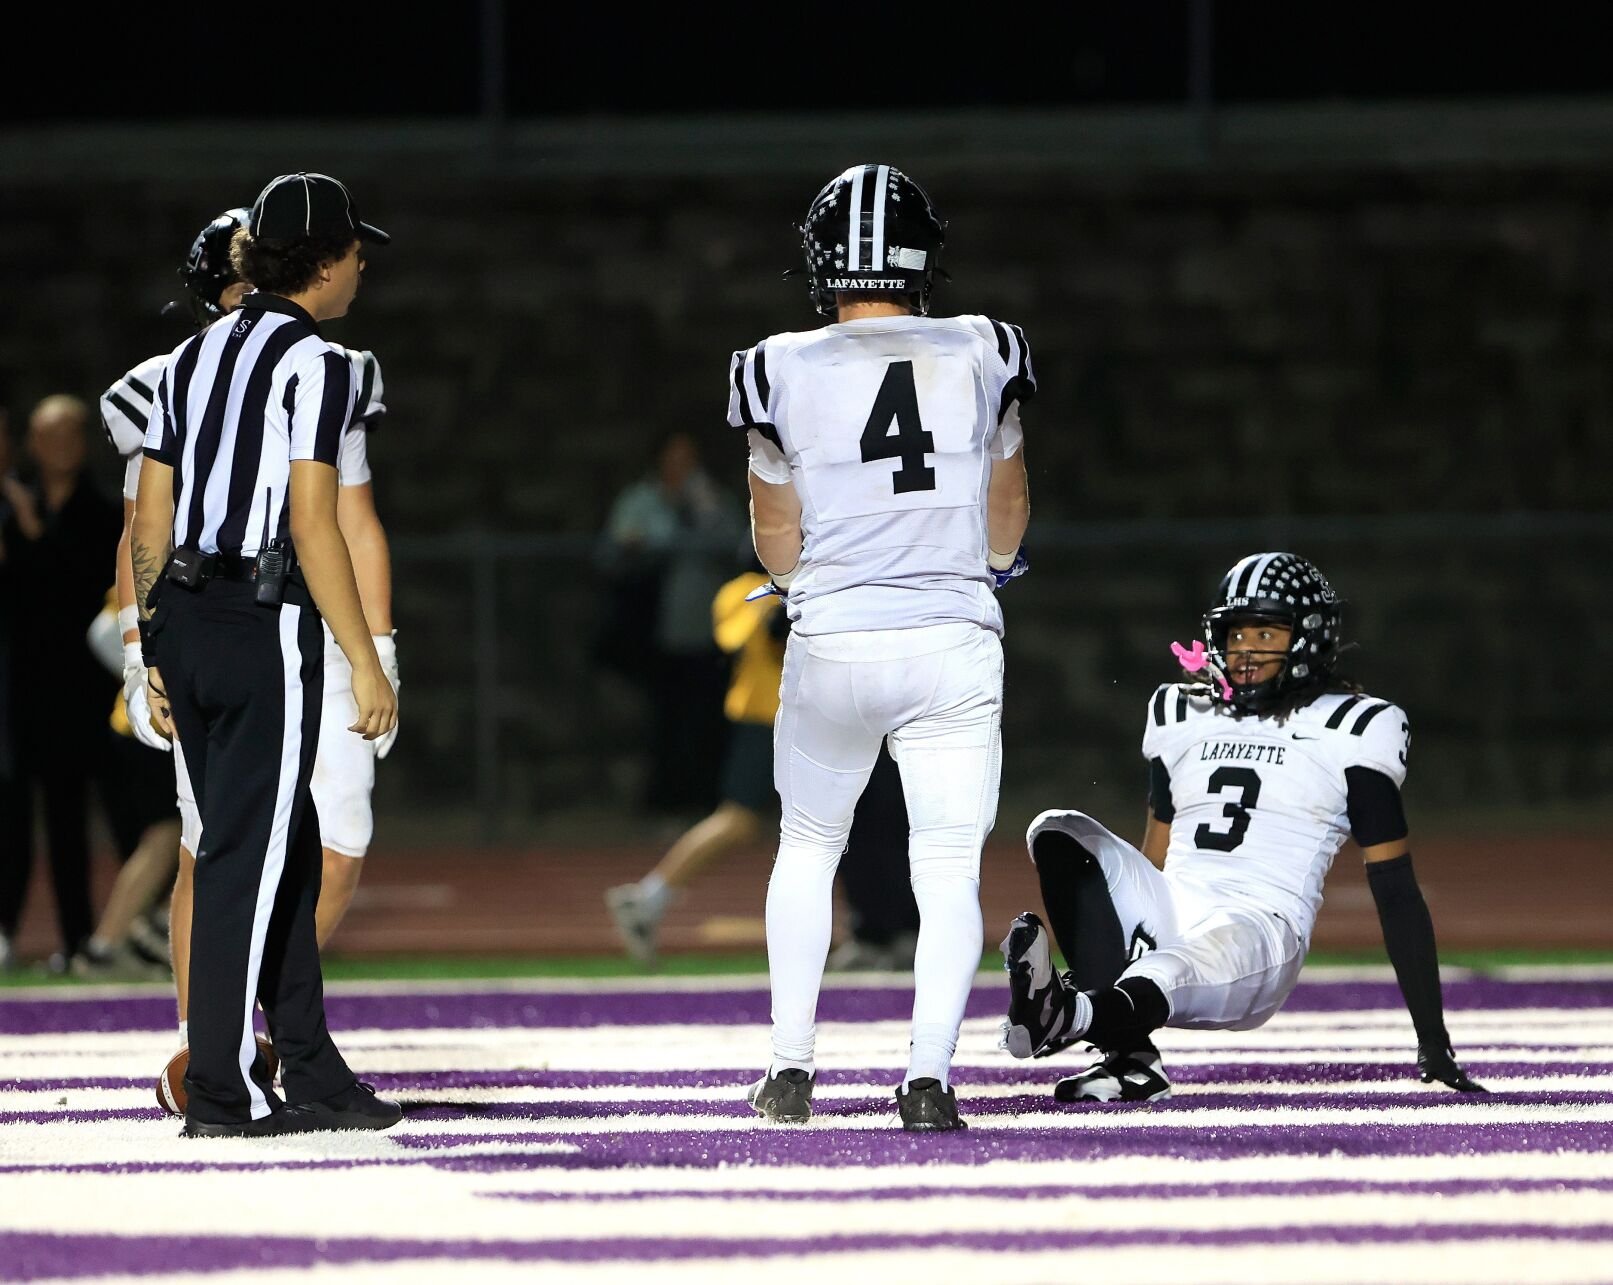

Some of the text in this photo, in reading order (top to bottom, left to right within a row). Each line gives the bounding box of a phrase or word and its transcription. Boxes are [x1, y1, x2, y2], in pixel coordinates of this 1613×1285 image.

[825, 278, 906, 289] LAFAYETTE
[859, 360, 936, 494] 4
[1225, 596, 1249, 609] LHS
[1200, 741, 1286, 765] LAFAYETTE
[1194, 766, 1262, 853] 3
